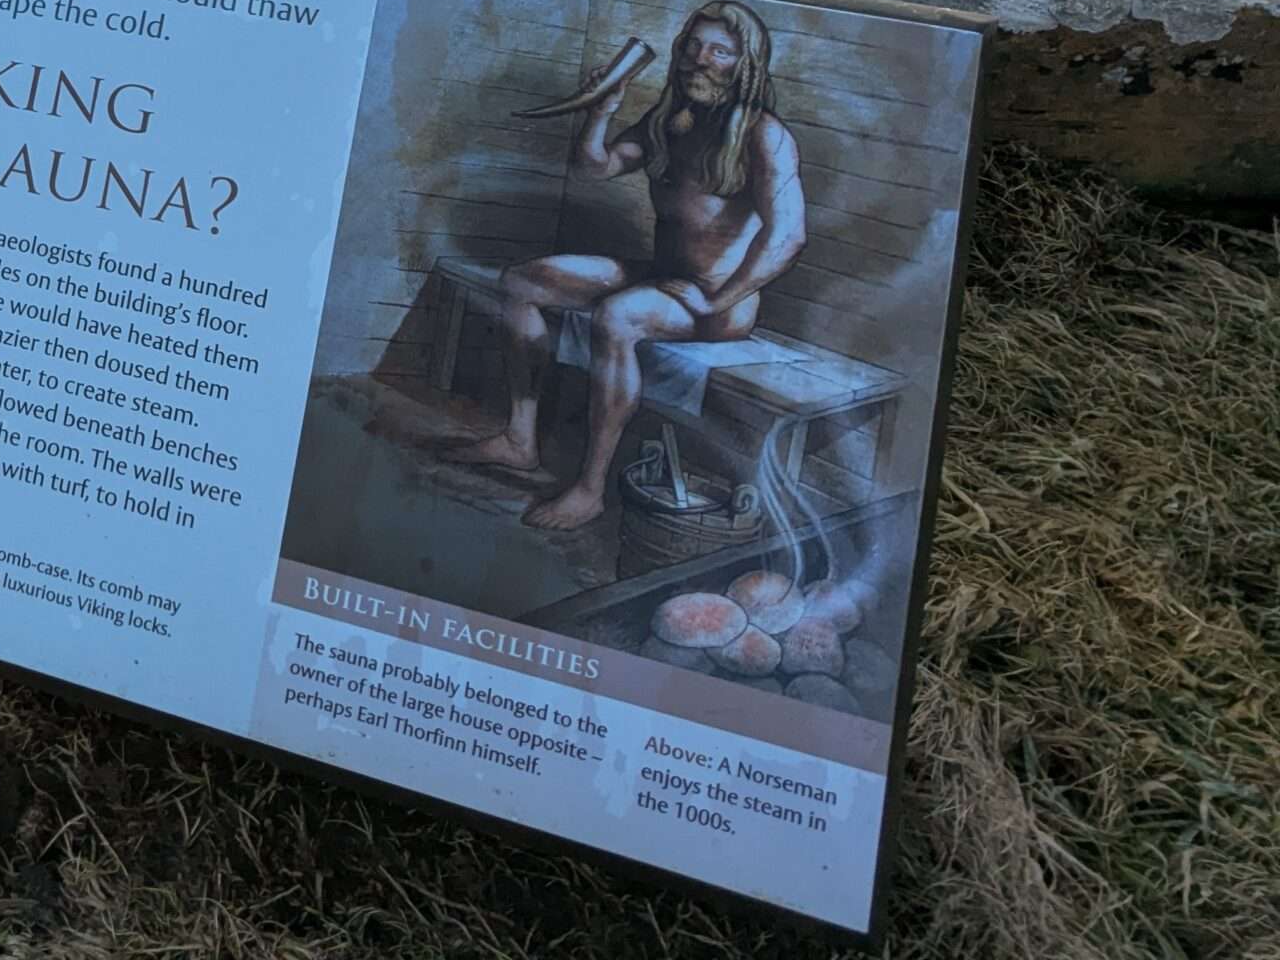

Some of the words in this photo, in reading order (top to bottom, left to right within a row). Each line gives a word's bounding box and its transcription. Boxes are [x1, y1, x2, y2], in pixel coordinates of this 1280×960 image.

[105, 10, 170, 41] cold.
[26, 272, 52, 291] on
[56, 274, 89, 300] the
[196, 307, 249, 339] floor.
[98, 251, 158, 284] found
[161, 272, 173, 288] a
[179, 269, 269, 309] hundred
[10, 299, 72, 328] would
[75, 310, 123, 341] have
[127, 323, 200, 360] heated
[204, 343, 259, 375] them
[44, 337, 89, 366] then
[94, 349, 171, 386] doused
[175, 370, 230, 401] them
[38, 370, 59, 391] to
[64, 380, 127, 409] create
[130, 396, 199, 428] steam.
[26, 436, 85, 465] room.
[91, 448, 128, 476] The
[133, 464, 185, 492] walls
[190, 479, 242, 507] were
[63, 405, 146, 448] beneath
[150, 429, 239, 472] benches
[2, 462, 45, 488] with
[51, 473, 92, 503] turf,
[96, 486, 118, 507] to
[123, 489, 172, 522] hold
[176, 505, 195, 529] in
[2, 572, 73, 608] luxurious
[77, 595, 126, 628] Viking
[128, 609, 172, 638] locks.
[76, 569, 96, 589] Its
[99, 580, 144, 603] comb
[147, 594, 182, 617] may
[304, 577, 431, 632] BUILT-IN
[443, 619, 600, 679] FACILITIES
[289, 663, 345, 689] owner
[347, 678, 369, 695] of
[369, 683, 398, 705] the
[402, 690, 446, 720] large
[449, 704, 504, 736] house
[507, 727, 588, 761] opposite
[295, 633, 326, 656] The
[328, 647, 378, 672] sauna
[382, 662, 461, 699] probably
[464, 681, 549, 722] belonged
[553, 710, 573, 728] to
[577, 715, 608, 739] the
[284, 688, 353, 720] perhaps
[357, 705, 389, 729] Earl
[393, 716, 467, 753] Thorfinn
[472, 739, 541, 776] himself.
[641, 767, 702, 796] enjoys
[707, 783, 739, 806] the
[743, 797, 803, 825] steam
[808, 811, 827, 833] in
[644, 736, 714, 769] Above:
[717, 757, 732, 775] A
[737, 761, 837, 806] Norseman
[637, 791, 669, 814] the
[675, 802, 736, 835] 1000s.
